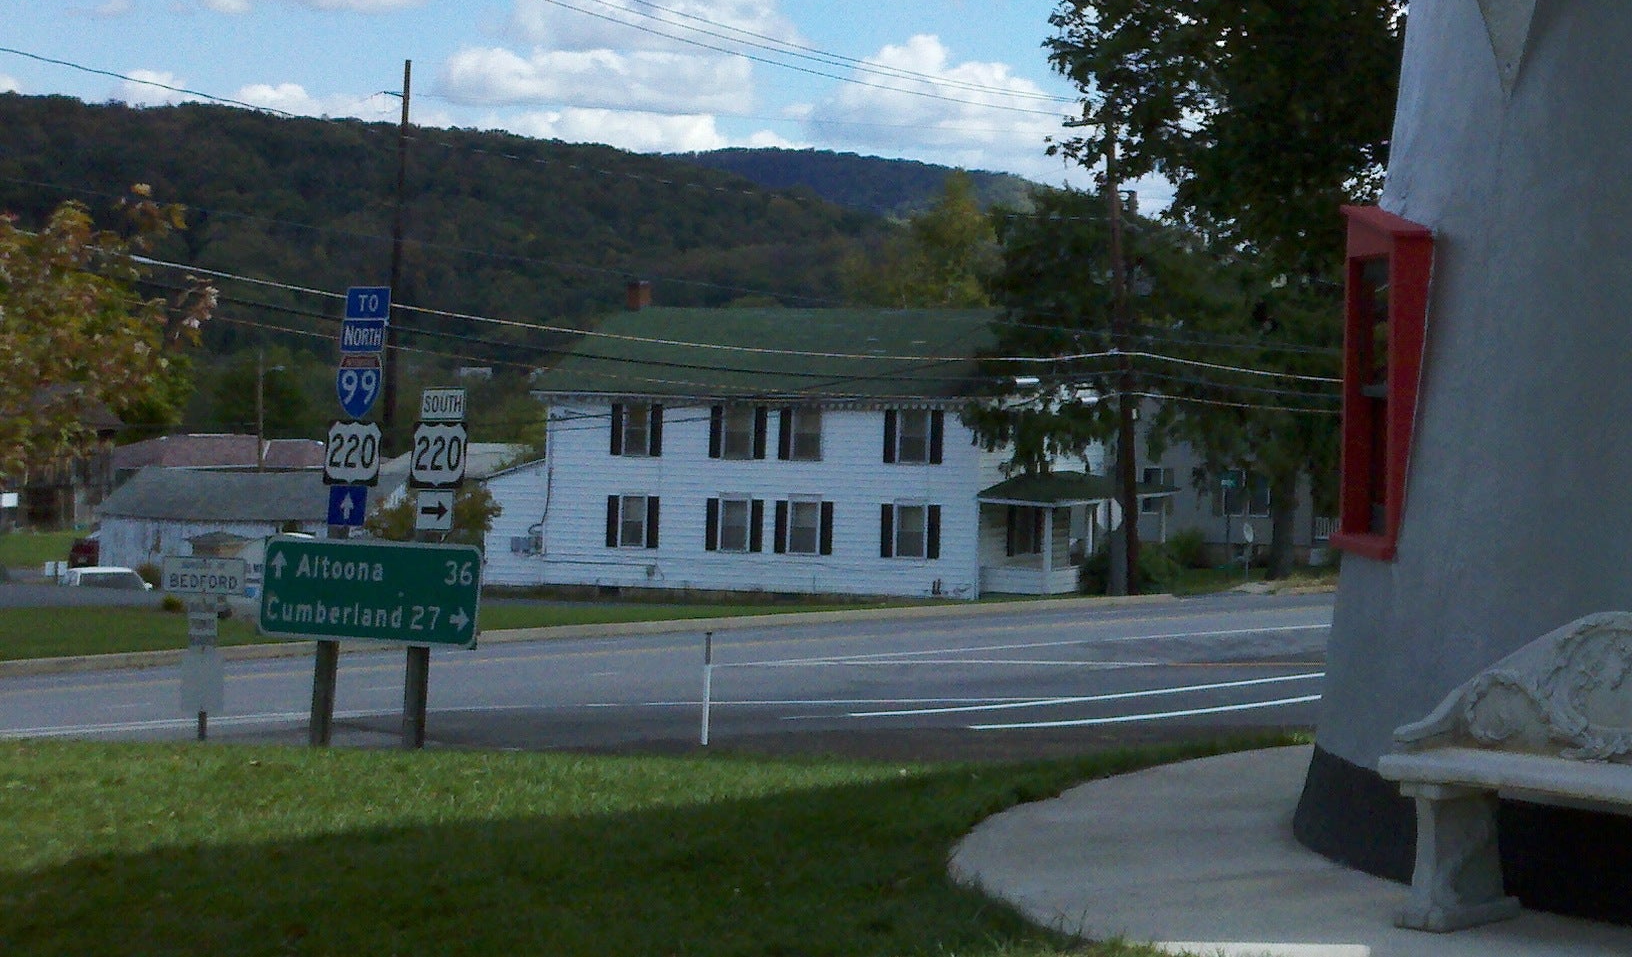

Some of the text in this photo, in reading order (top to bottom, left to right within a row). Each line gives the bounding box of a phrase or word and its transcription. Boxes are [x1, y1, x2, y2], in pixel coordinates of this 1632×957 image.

[358, 293, 379, 313] TO
[344, 324, 381, 346] NORTH
[341, 369, 377, 405] 99
[423, 394, 463, 414] SOUTH
[328, 432, 376, 469] 220
[414, 435, 462, 472] 220
[168, 572, 239, 590] BEDFORD
[295, 553, 473, 586] Altoona 36
[266, 595, 441, 631] Cumberland 27
